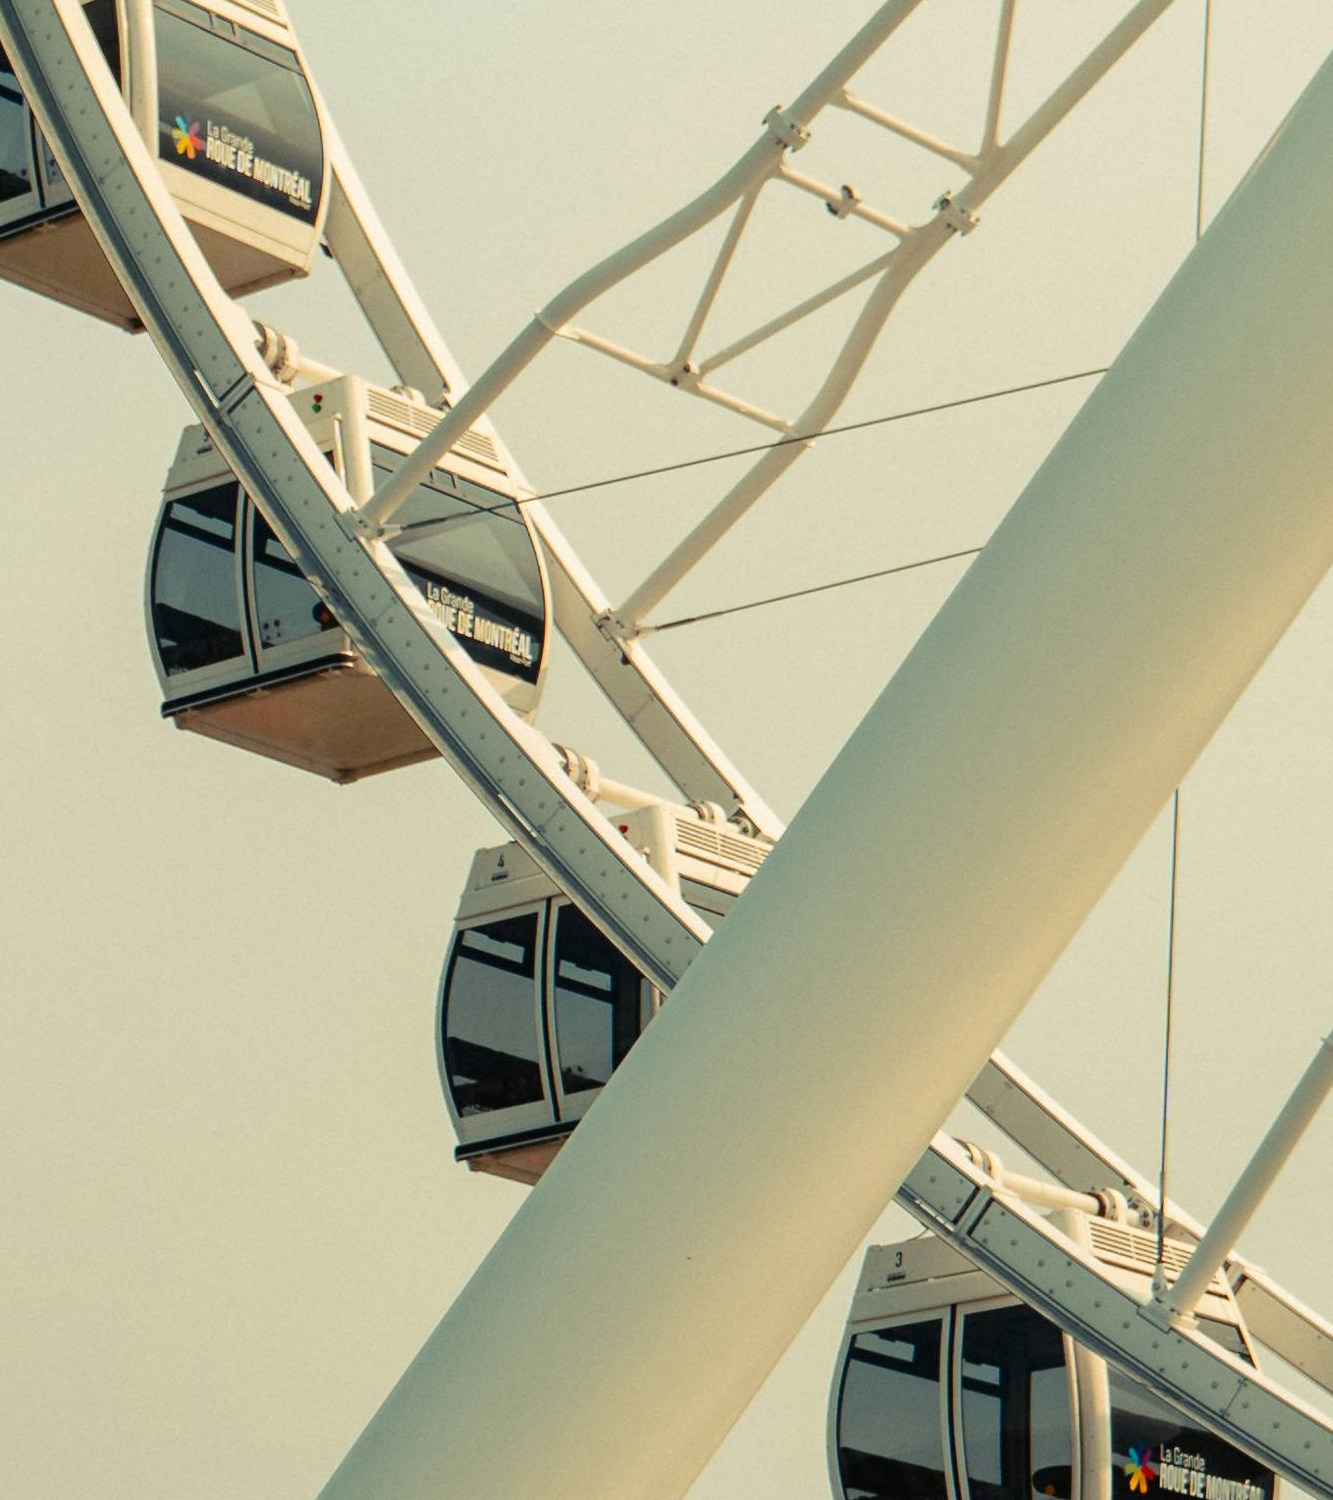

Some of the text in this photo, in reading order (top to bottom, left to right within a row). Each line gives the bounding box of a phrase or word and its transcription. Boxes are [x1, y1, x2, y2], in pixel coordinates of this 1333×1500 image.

[205, 136, 238, 170] ROUE
[236, 150, 254, 178] DE
[252, 156, 312, 204] MONTRÉAL
[440, 586, 474, 613] Grande
[456, 611, 474, 638] DE
[473, 616, 533, 661] MONTRÉAL
[895, 1251, 903, 1268] 3
[1160, 1443, 1206, 1472] La Grande
[1159, 1463, 1189, 1495] ROUE
[1189, 1471, 1206, 1499] DE
